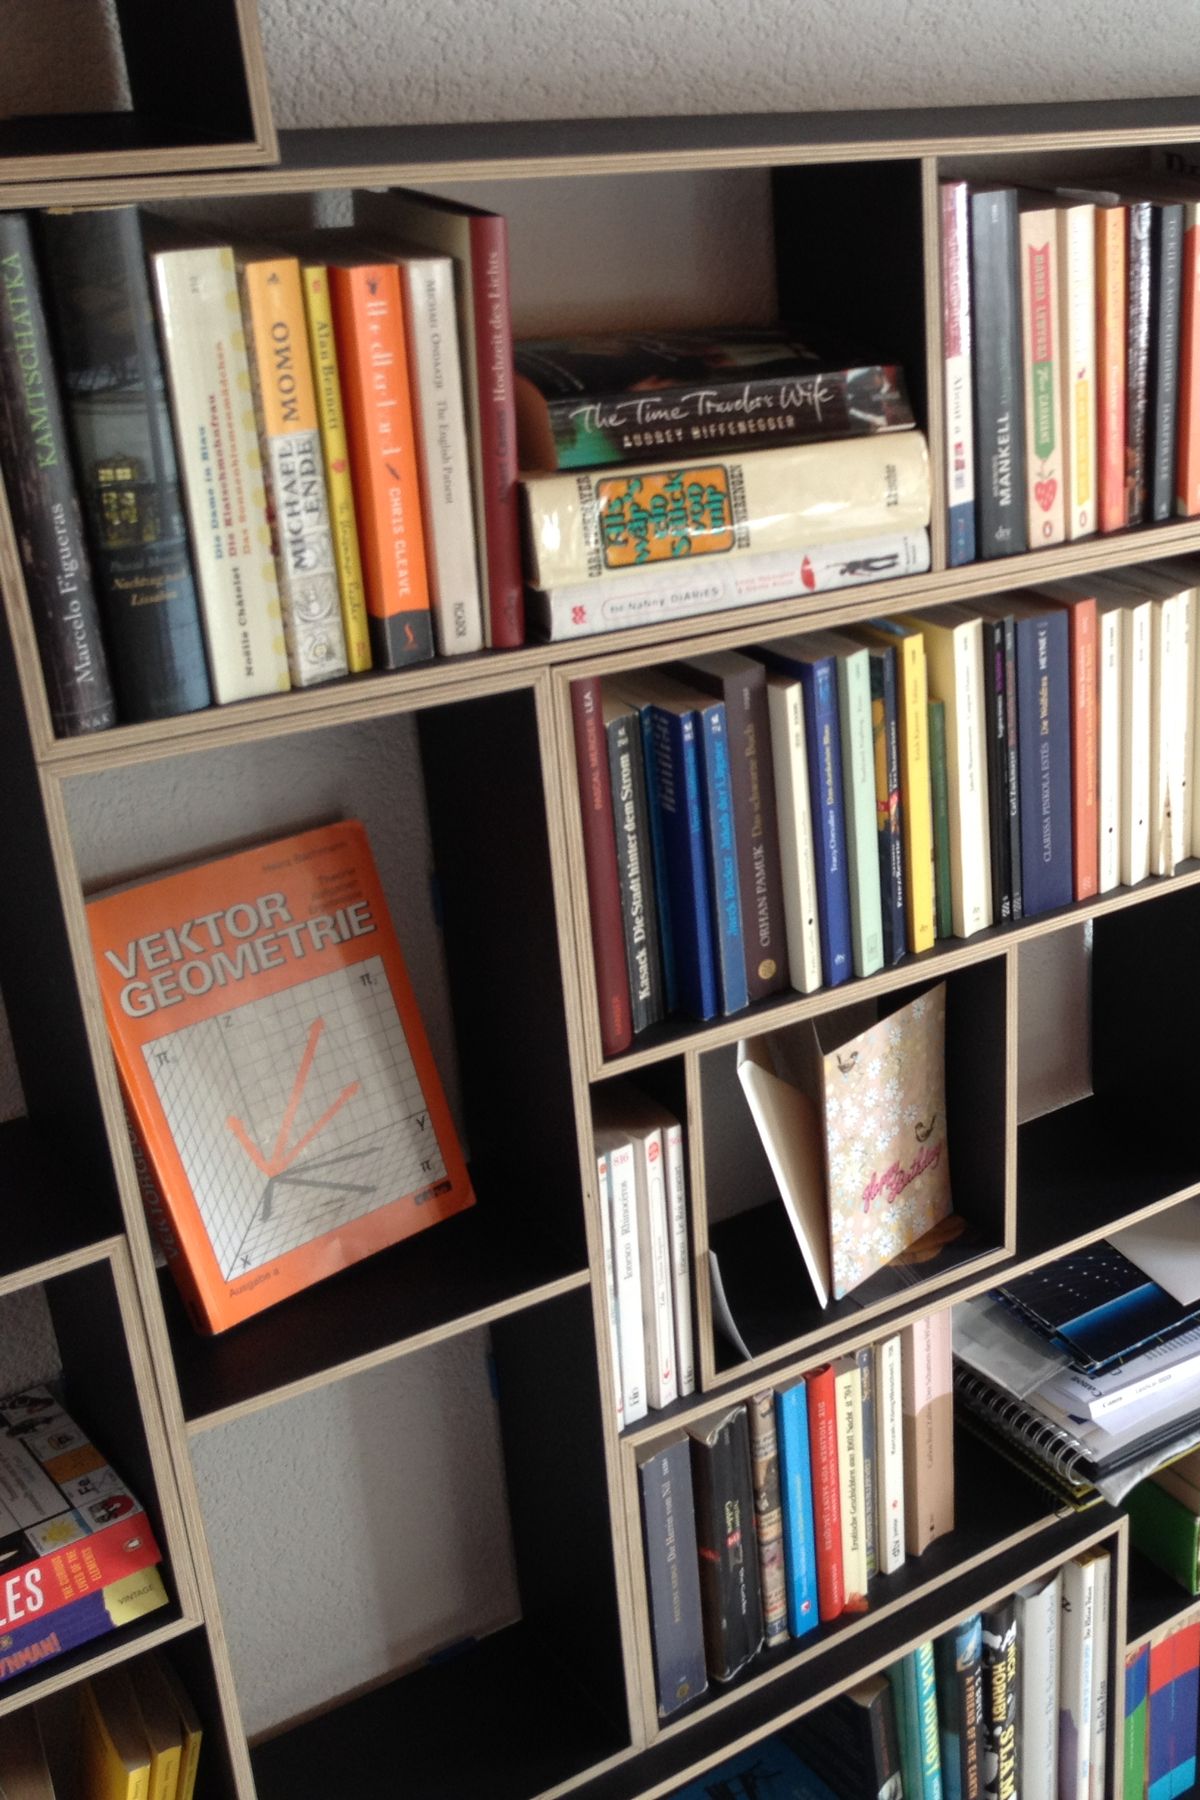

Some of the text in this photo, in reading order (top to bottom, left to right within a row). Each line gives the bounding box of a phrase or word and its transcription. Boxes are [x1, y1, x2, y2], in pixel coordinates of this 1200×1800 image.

[490, 309, 502, 332] des
[2, 253, 58, 469] KAMTSCHATKA
[272, 321, 298, 422] MOMO
[317, 321, 337, 430] Alan Bennett
[493, 339, 507, 402] Hochzeit
[952, 376, 962, 416] About
[1160, 289, 1175, 454] MOCKINGBIRD HARPER
[570, 374, 835, 434] The Time Wife
[623, 414, 795, 448] AUDREY NIFFENEGGER
[298, 440, 322, 516] ENDE
[438, 400, 453, 504] The English Patient
[995, 412, 1013, 508] MANKELL
[209, 488, 224, 559] Die Dame
[279, 440, 305, 569] MICHAEL
[389, 488, 412, 597] CHRIS CLEAVE
[226, 536, 238, 557] Die
[53, 503, 95, 683] Marcelo Figueras
[452, 602, 467, 637] PICADOR
[583, 691, 594, 714] LEA
[744, 724, 756, 757] Buch
[587, 718, 603, 810] PASCAL MERCIER
[1007, 750, 1017, 798] Zuckmayer
[1038, 635, 1052, 862] CLARISSA PINKOLA Wolfsfrau HEYNE
[711, 740, 738, 936] Jurek Becker Jakob der Lügner
[751, 813, 762, 839] Das
[826, 808, 839, 874] Tracy Chevalier
[620, 751, 651, 1001] Kasack Die Stadt hinter dem Strom
[753, 844, 772, 948] ORHAN PAMUK
[106, 892, 292, 980] VEKTOR
[119, 901, 377, 1019] GEOMETRIE
[620, 1180, 633, 1282] Ionesco Rhinocéros
[229, 1274, 271, 1299] Ausgabe
[846, 1410, 859, 1553] Erotische Geschichten Nacht
[82, 1546, 101, 1583] ELEMENTS
[665, 1517, 677, 1562] Die Herrin
[51, 1556, 74, 1600] THE CURIOUS
[75, 1574, 89, 1593] LIVES
[118, 1584, 156, 1607] VINTAGE
[992, 1660, 1008, 1722] HORNBY
[1007, 1640, 1017, 1685] NICK
[918, 1641, 941, 1776] NICK HORNBY
[966, 1685, 978, 1800] FRIEND THE EARTH
[1000, 1724, 1016, 1800] SLAM
